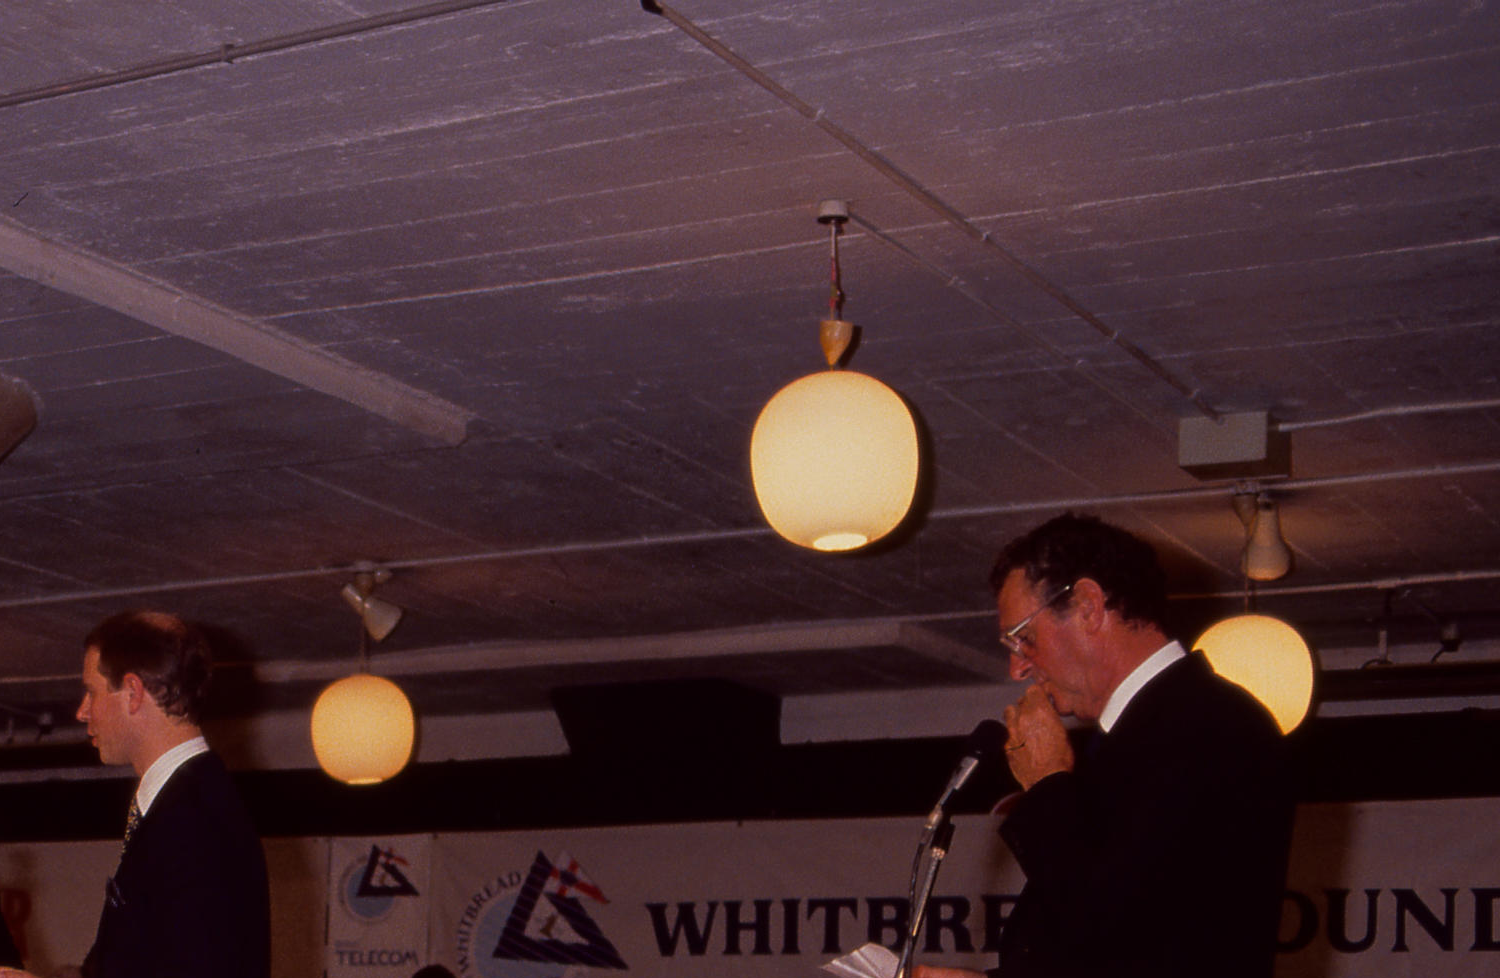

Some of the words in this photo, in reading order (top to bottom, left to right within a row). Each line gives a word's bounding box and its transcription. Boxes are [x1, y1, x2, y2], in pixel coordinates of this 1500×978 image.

[457, 870, 522, 973] WHITBREAD
[645, 893, 1022, 957] WHITBRE
[1275, 887, 1500, 953] OUND
[336, 948, 419, 967] TELECOM
